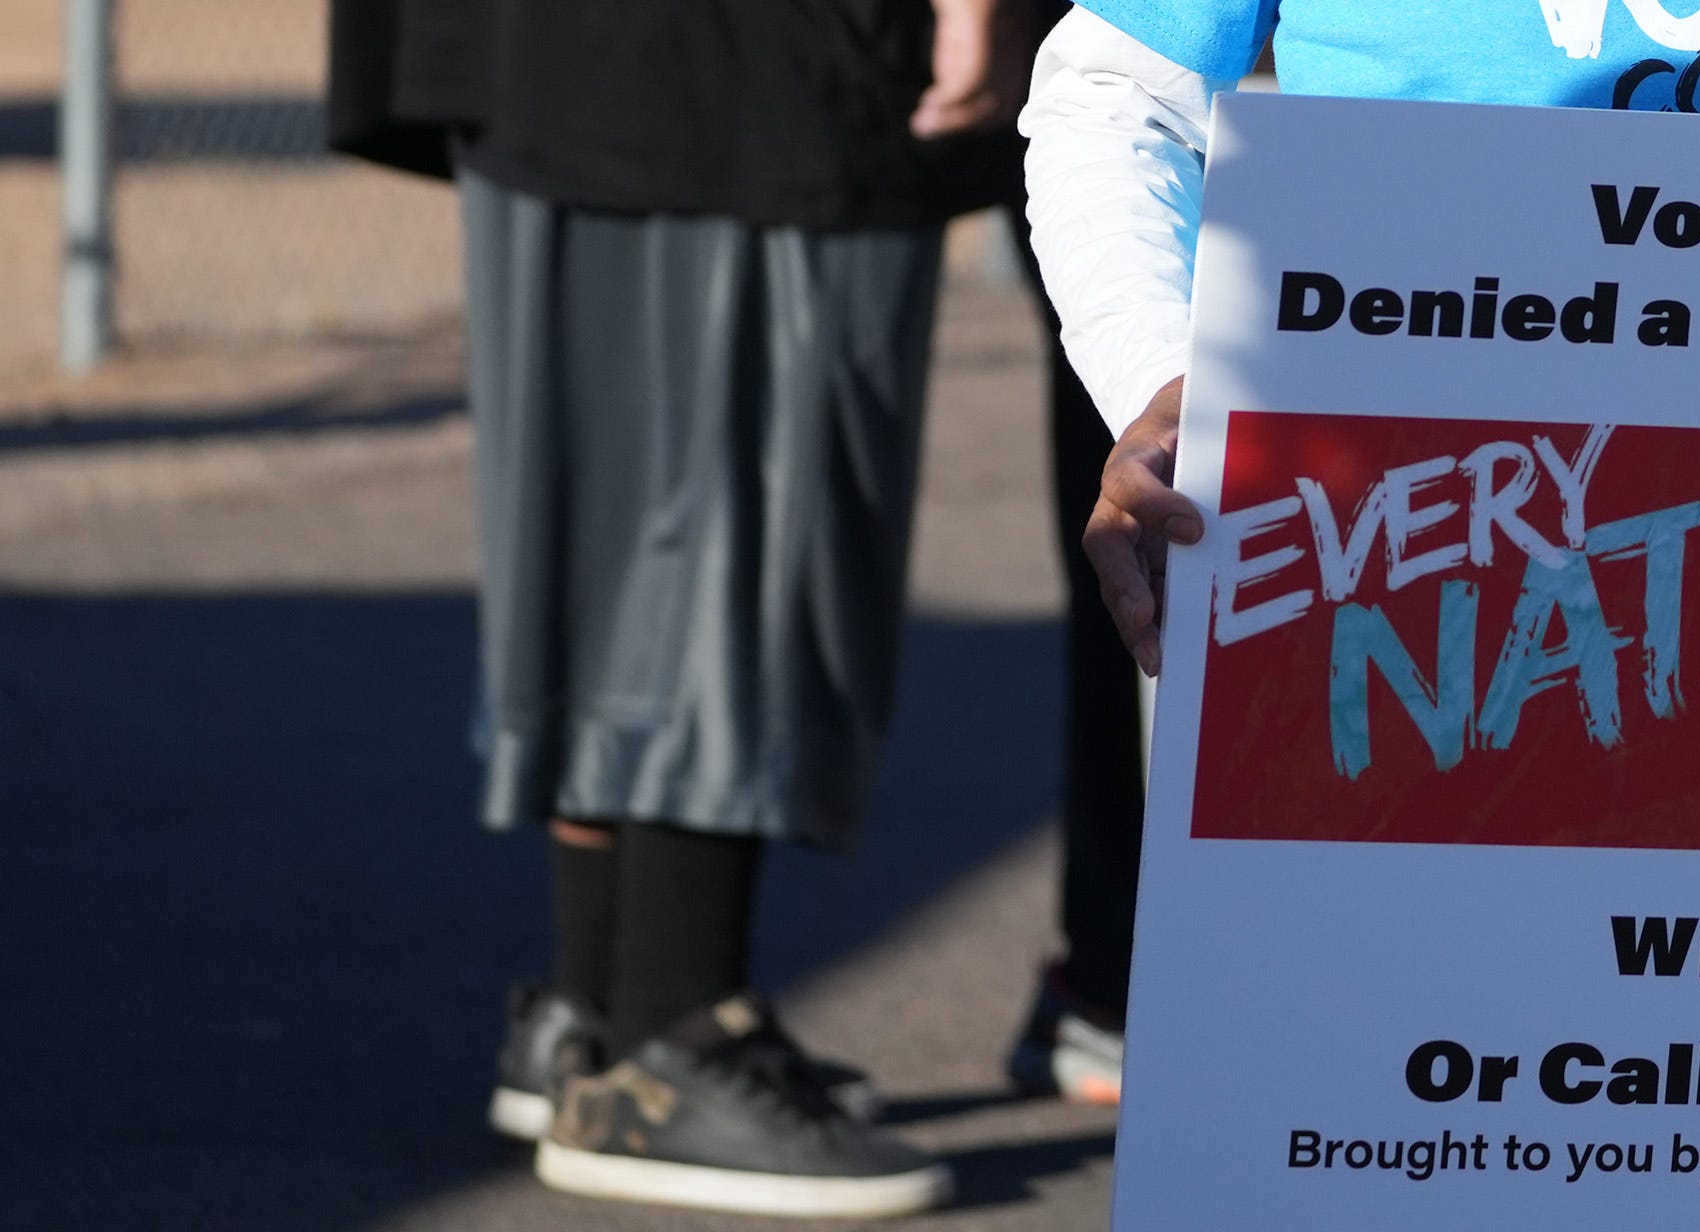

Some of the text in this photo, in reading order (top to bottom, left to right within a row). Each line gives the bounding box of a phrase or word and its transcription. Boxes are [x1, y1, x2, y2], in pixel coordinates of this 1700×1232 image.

[1277, 271, 1619, 345] Denied
[1637, 299, 1691, 348] a
[1213, 424, 1617, 647] EVERY
[1405, 1040, 1518, 1103] Or
[1288, 1129, 1489, 1180] Brought
[1503, 1136, 1551, 1172] to
[1566, 1143, 1655, 1182] you
